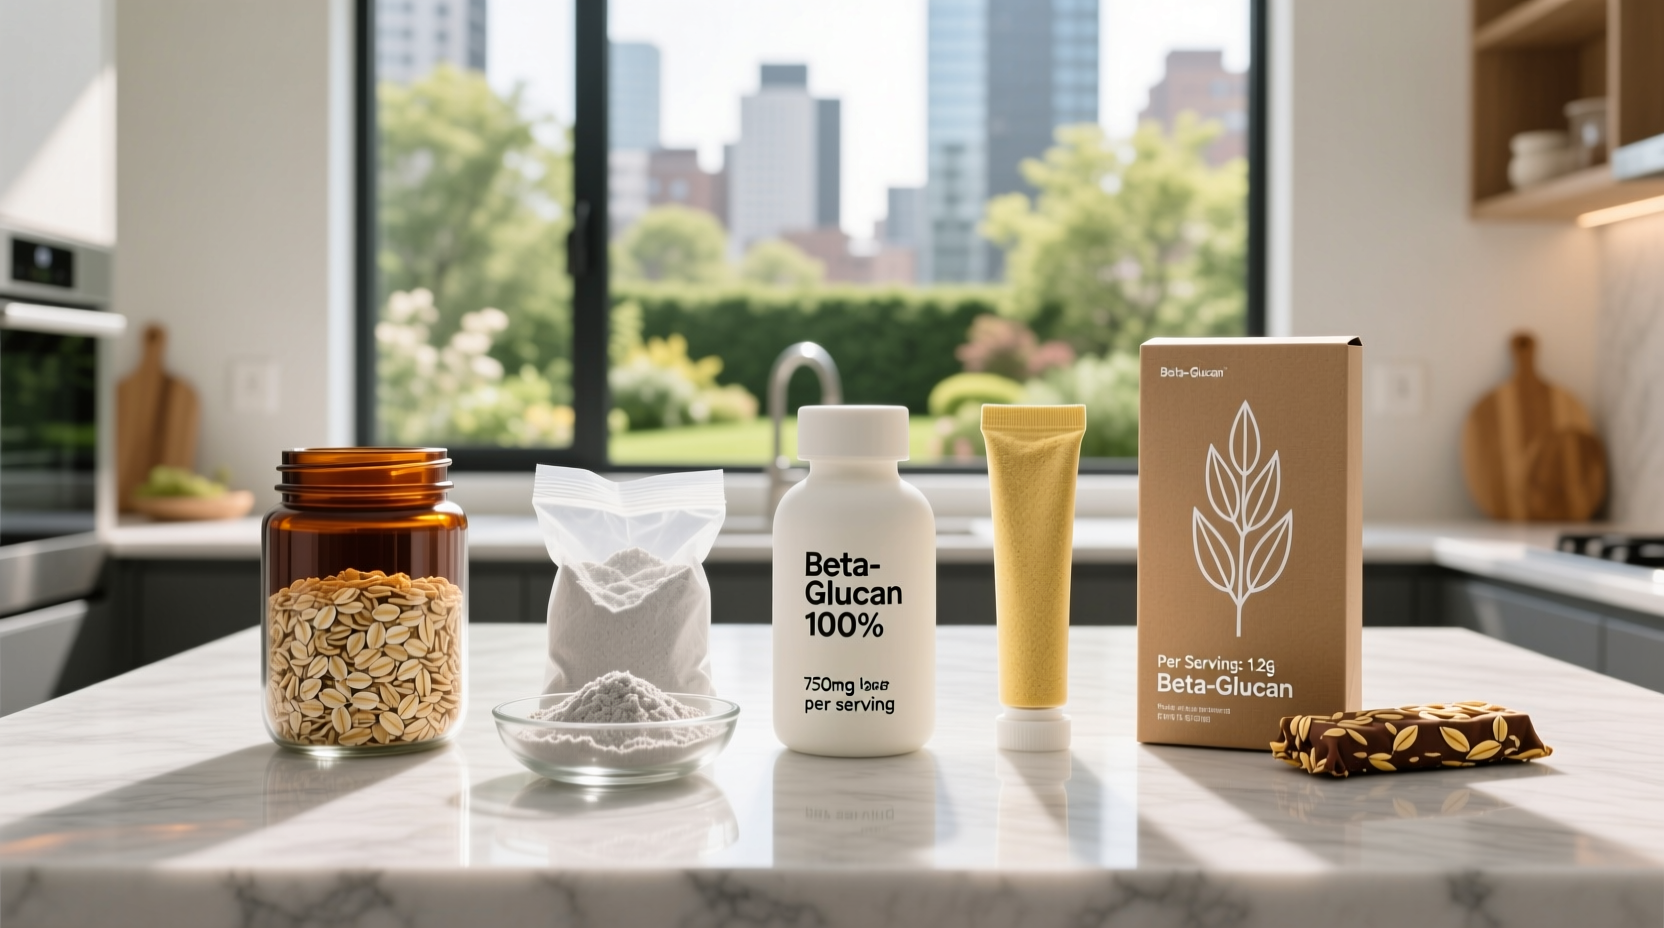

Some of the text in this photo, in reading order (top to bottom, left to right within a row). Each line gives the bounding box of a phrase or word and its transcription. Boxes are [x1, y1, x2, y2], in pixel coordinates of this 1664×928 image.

[805, 551, 880, 577] Beta-
[805, 580, 902, 606] Glucan
[805, 611, 884, 638] 100%
[1157, 654, 1181, 669] Per
[1184, 655, 1243, 674] Serving:
[804, 676, 855, 696] 750mg
[1157, 672, 1293, 699] Beta-Glucan
[805, 696, 895, 715] per serving
